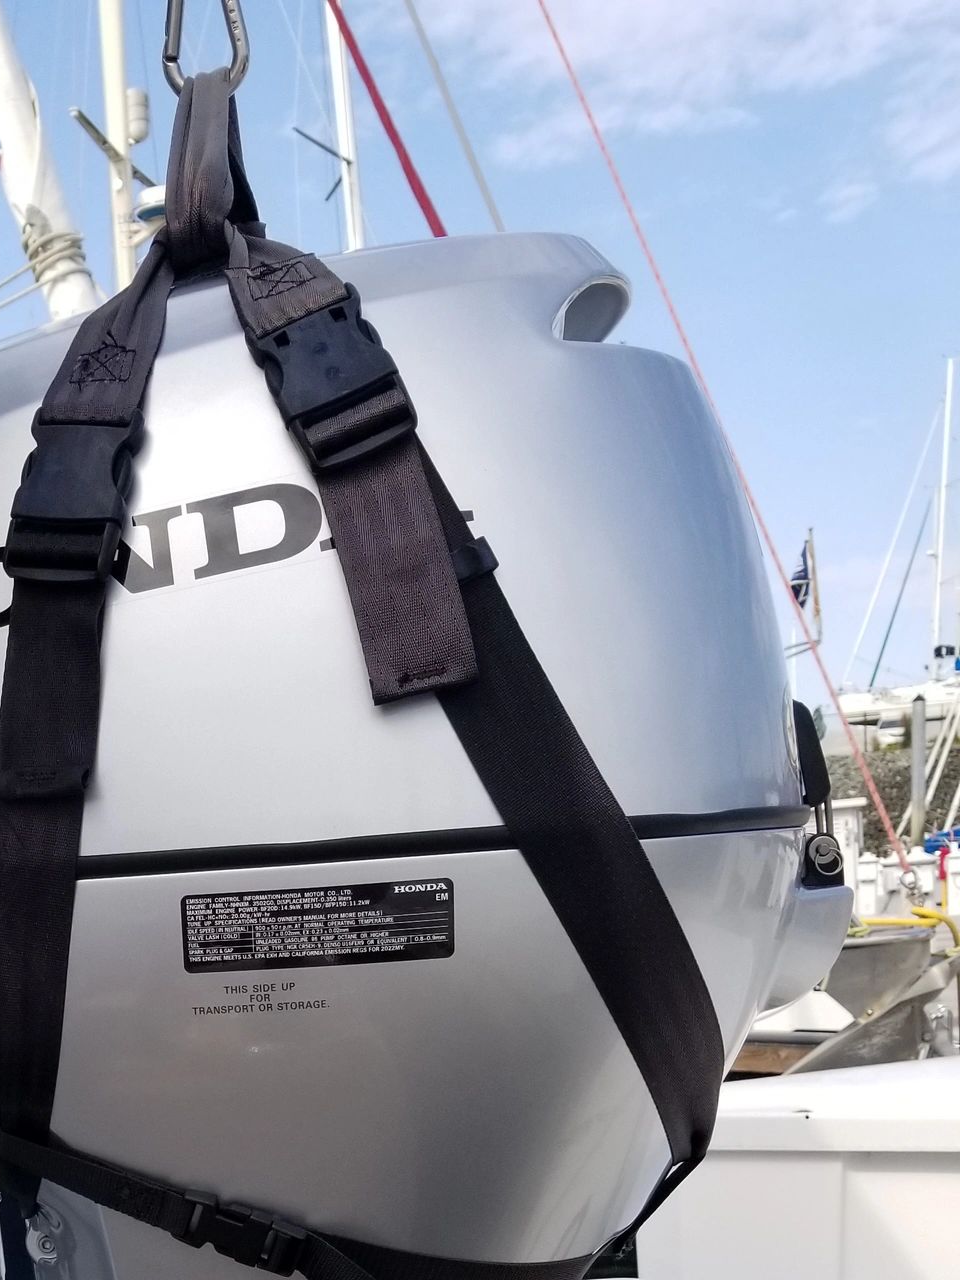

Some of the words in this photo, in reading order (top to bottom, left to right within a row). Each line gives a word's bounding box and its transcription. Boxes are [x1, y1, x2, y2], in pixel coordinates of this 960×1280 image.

[393, 882, 448, 893] HONDA
[435, 892, 449, 901] EM
[377, 937, 407, 945] EQUIVALENT
[224, 985, 248, 994] THIS
[253, 984, 276, 993] SIDE
[281, 982, 296, 991] UP
[249, 994, 270, 1003] FOR
[192, 1004, 255, 1015] TRANSPORT
[258, 1003, 273, 1012] OR
[277, 1000, 330, 1011] STORAGE.
